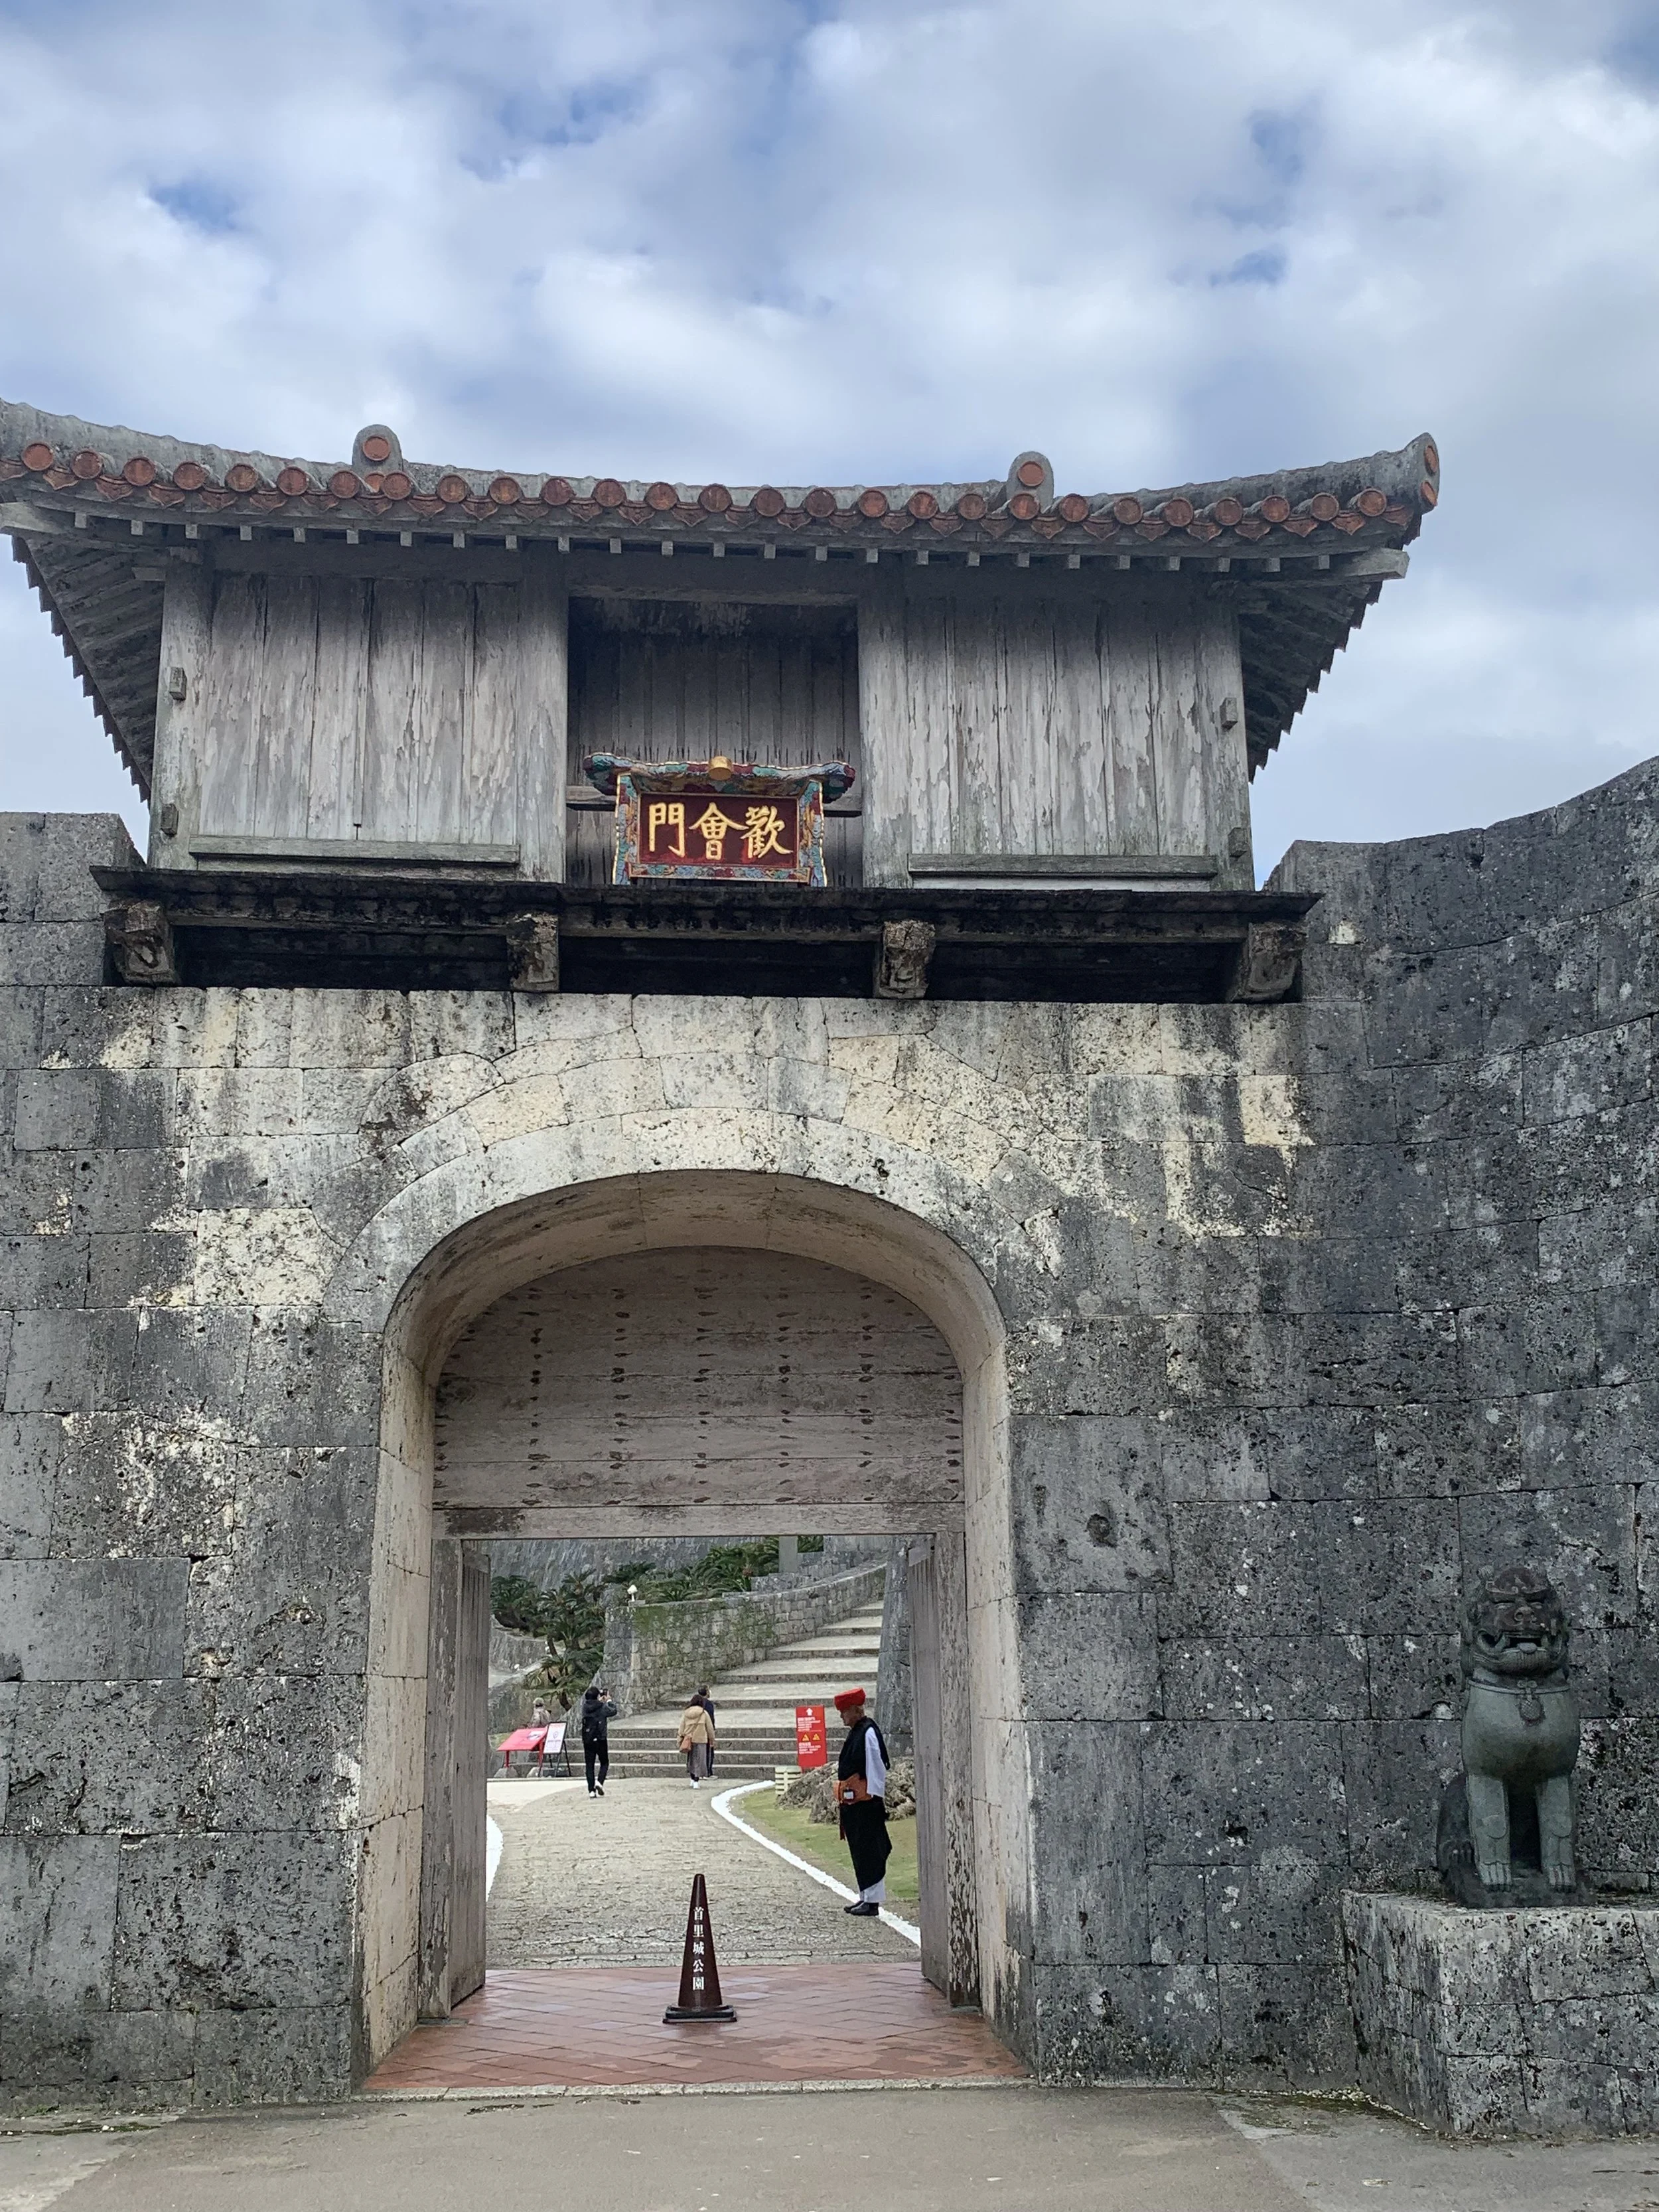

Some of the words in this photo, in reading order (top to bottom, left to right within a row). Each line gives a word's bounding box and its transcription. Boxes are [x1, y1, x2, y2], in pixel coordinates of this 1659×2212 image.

[692, 1906, 705, 1991] 首里城公園
